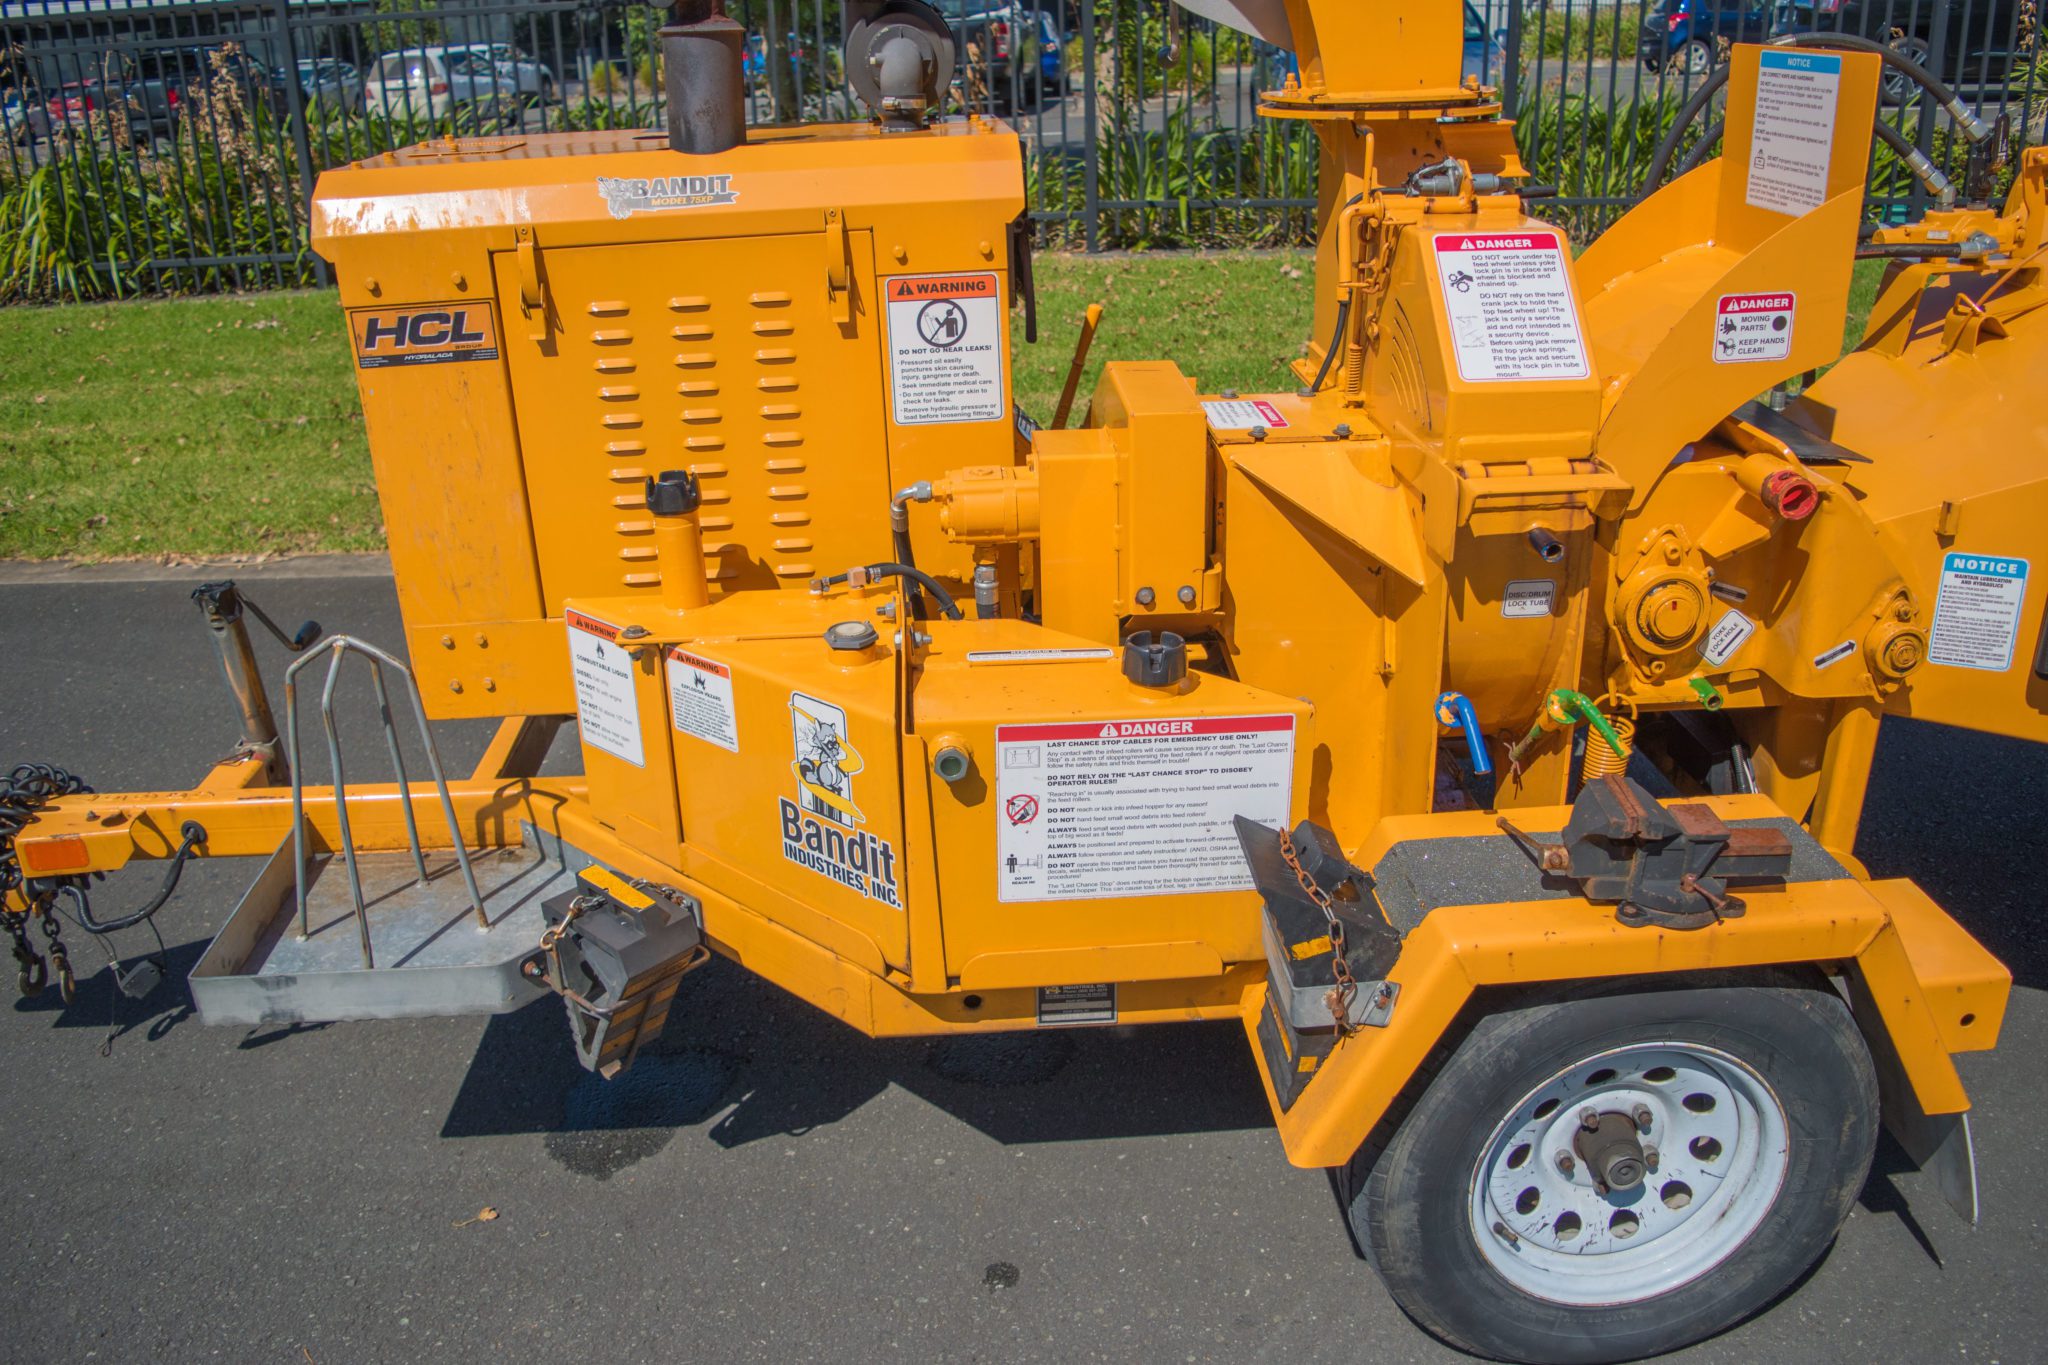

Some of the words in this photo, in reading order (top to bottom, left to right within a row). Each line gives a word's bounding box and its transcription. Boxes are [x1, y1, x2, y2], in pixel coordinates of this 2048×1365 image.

[1788, 58, 1810, 68] NOTICE
[632, 176, 731, 197] BANDIT
[652, 196, 687, 206] MODEL
[690, 196, 714, 204] 75XP
[1476, 239, 1532, 248] DANGER
[1539, 259, 1556, 267] yoke
[916, 281, 986, 294] WARNING
[1740, 298, 1789, 309] DANGER
[364, 311, 485, 350] HCL
[1760, 337, 1784, 345] HANDS
[944, 357, 962, 365] easily
[901, 365, 932, 373] punctures
[949, 364, 974, 372] causing
[938, 389, 956, 397] finger
[930, 404, 959, 412] hydraulic
[940, 411, 971, 419] loosening
[1953, 558, 2018, 574] NOTICE
[1980, 576, 2012, 584] LUBRICATION
[584, 621, 617, 640] WARNING
[1712, 625, 1726, 640] YOKE
[1710, 638, 1725, 653] LOCK
[1724, 623, 1739, 638] HOLE
[576, 654, 611, 672] COMBUSTABLE
[612, 668, 628, 679] LIQUID
[685, 655, 719, 674] WARNING
[576, 669, 592, 679] DIESEL
[586, 682, 595, 691] NOT
[589, 702, 598, 710] NOT
[591, 721, 601, 729] NOT
[1121, 722, 1193, 736] DANGER
[1171, 735, 1217, 743] EMERGENCY
[1048, 779, 1087, 787] OPERATOR
[780, 798, 895, 886] Bandit
[784, 841, 868, 896] INDUSTRIES,
[871, 880, 901, 908] INC.
